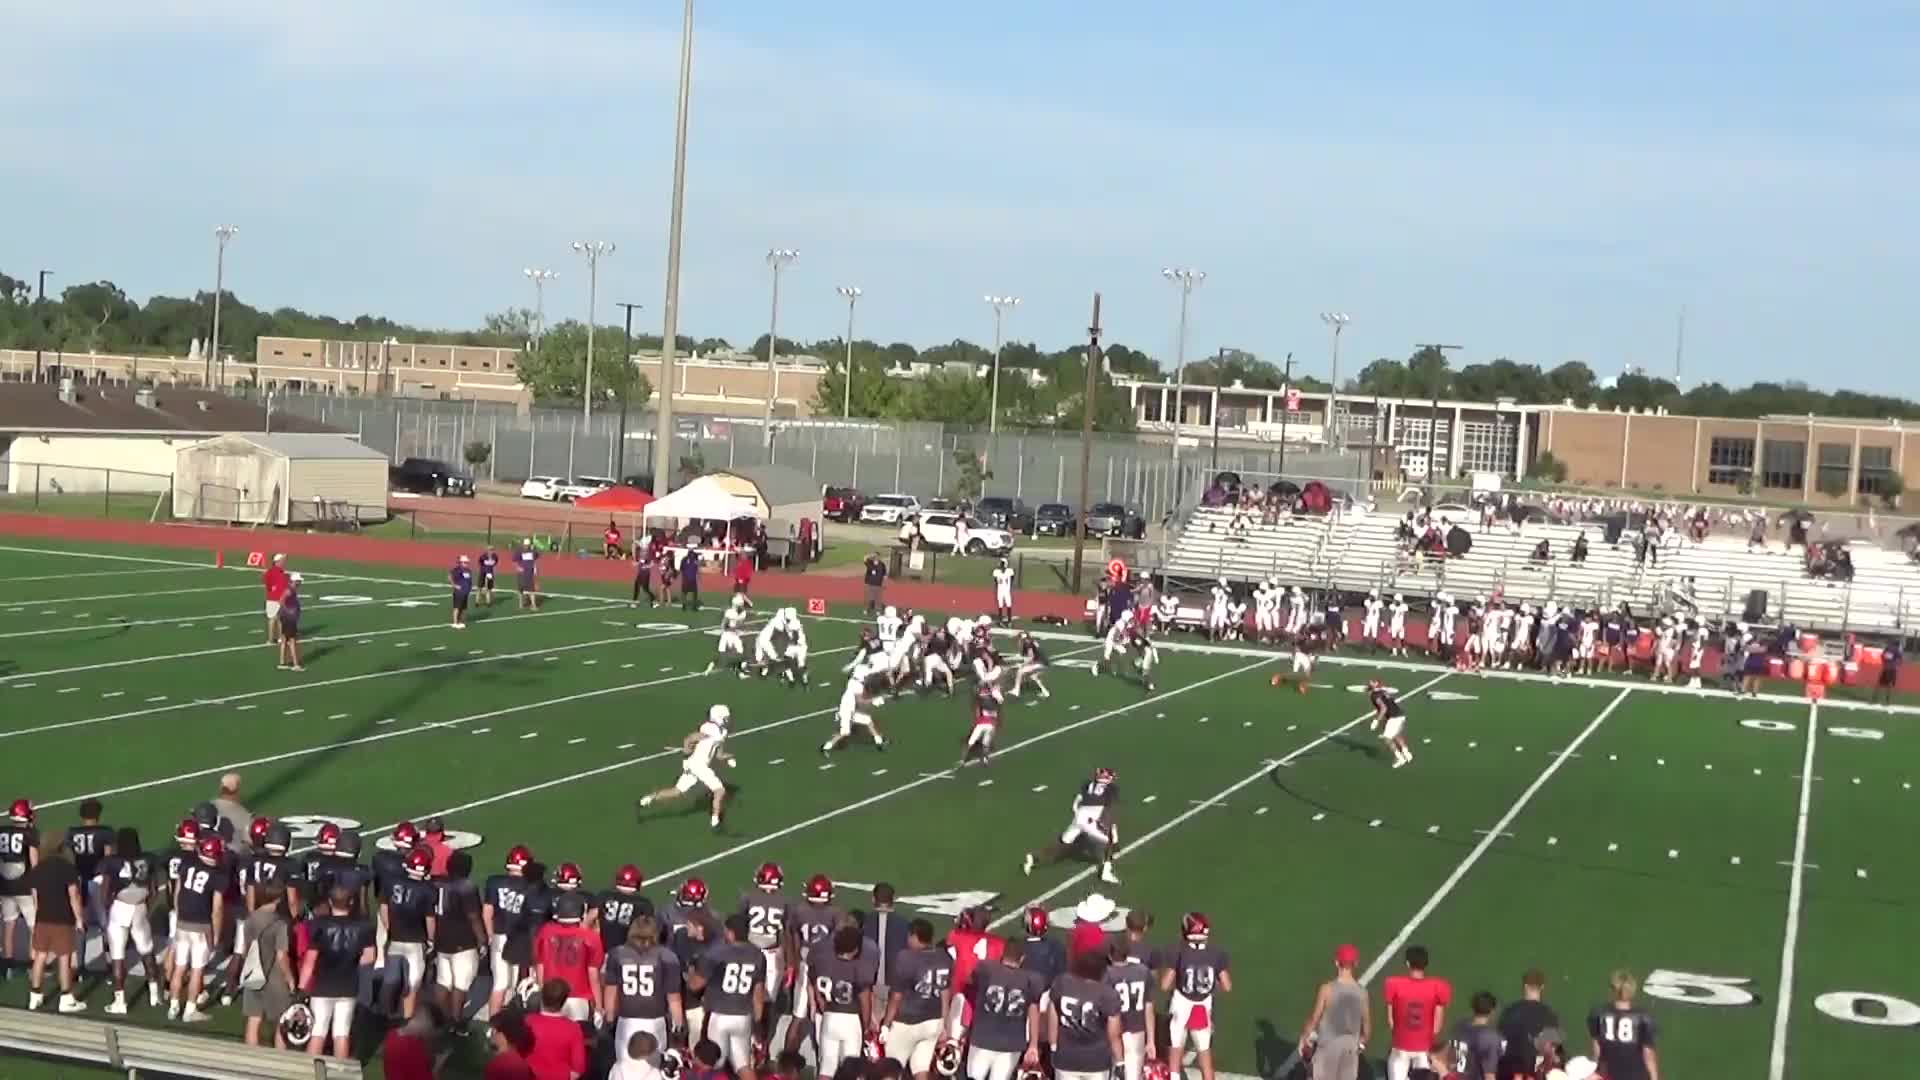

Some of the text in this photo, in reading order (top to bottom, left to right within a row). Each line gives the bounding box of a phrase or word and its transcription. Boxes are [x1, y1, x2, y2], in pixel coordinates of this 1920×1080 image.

[253, 861, 277, 884] 17
[748, 905, 784, 935] 25
[622, 964, 655, 997] 55
[722, 963, 756, 995] 65
[816, 976, 853, 1004] 93
[1643, 969, 1920, 1026] 5 0
[1604, 1017, 1634, 1042] 18
